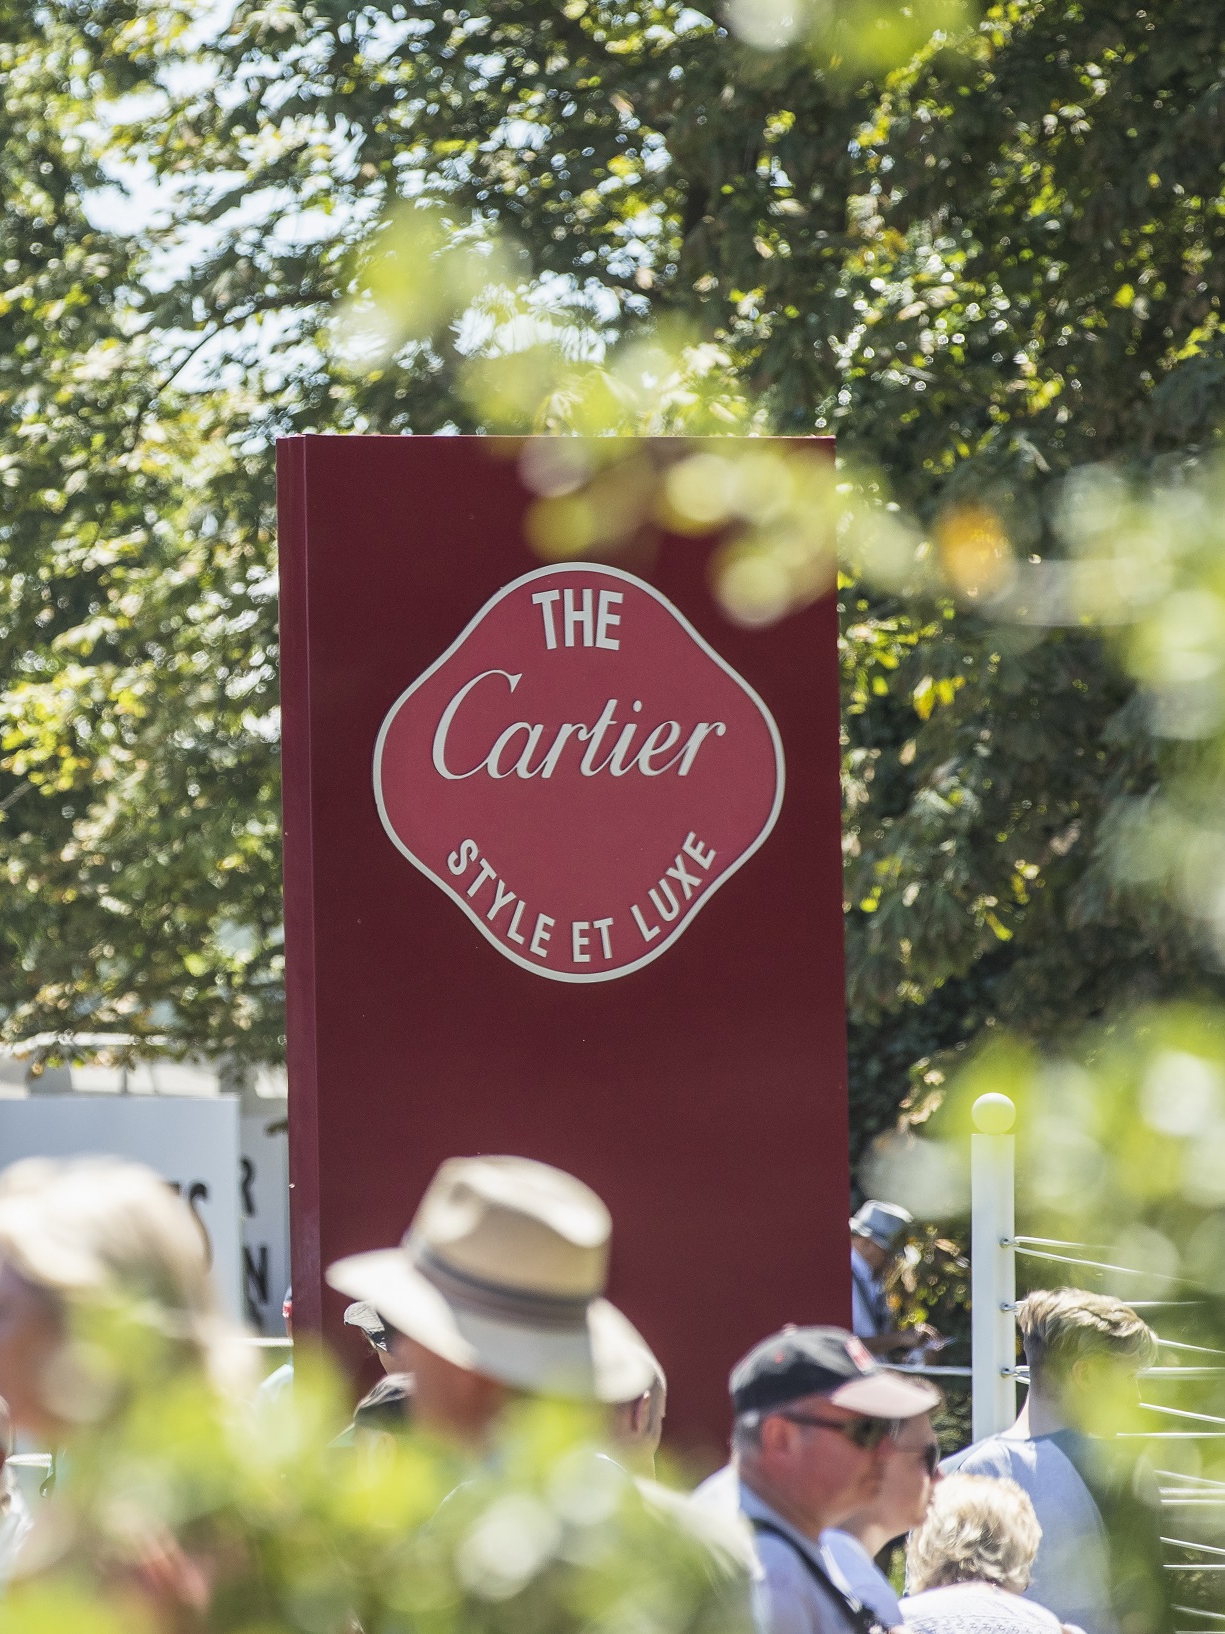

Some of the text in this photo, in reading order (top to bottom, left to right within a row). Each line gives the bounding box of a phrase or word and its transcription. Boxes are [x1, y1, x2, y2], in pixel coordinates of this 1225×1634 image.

[531, 588, 624, 651] THE
[431, 669, 727, 780] Cartier
[447, 831, 717, 963] STYLE ET LUXE
